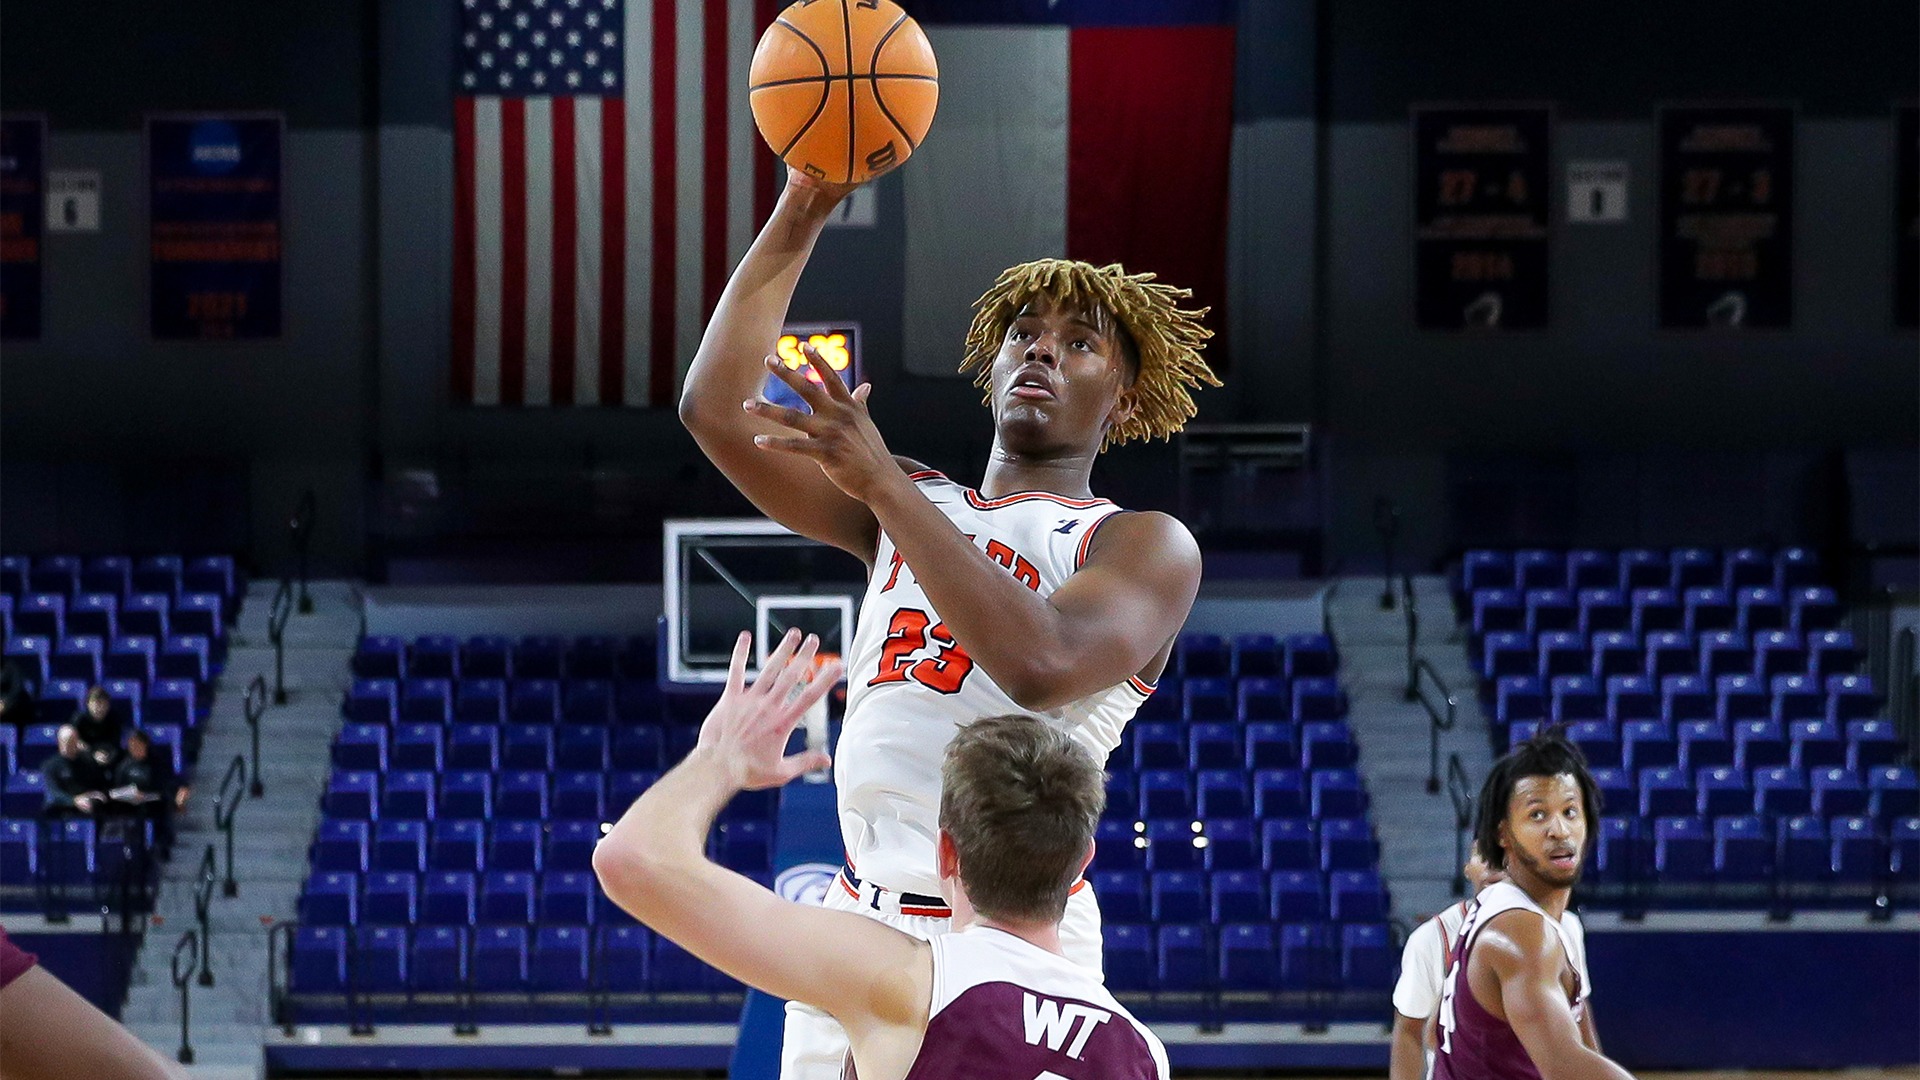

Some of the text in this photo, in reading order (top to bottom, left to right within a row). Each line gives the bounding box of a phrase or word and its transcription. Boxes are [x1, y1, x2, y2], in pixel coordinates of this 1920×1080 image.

[63, 196, 78, 226] 6
[867, 607, 975, 695] 23
[1022, 991, 1112, 1060] WT
